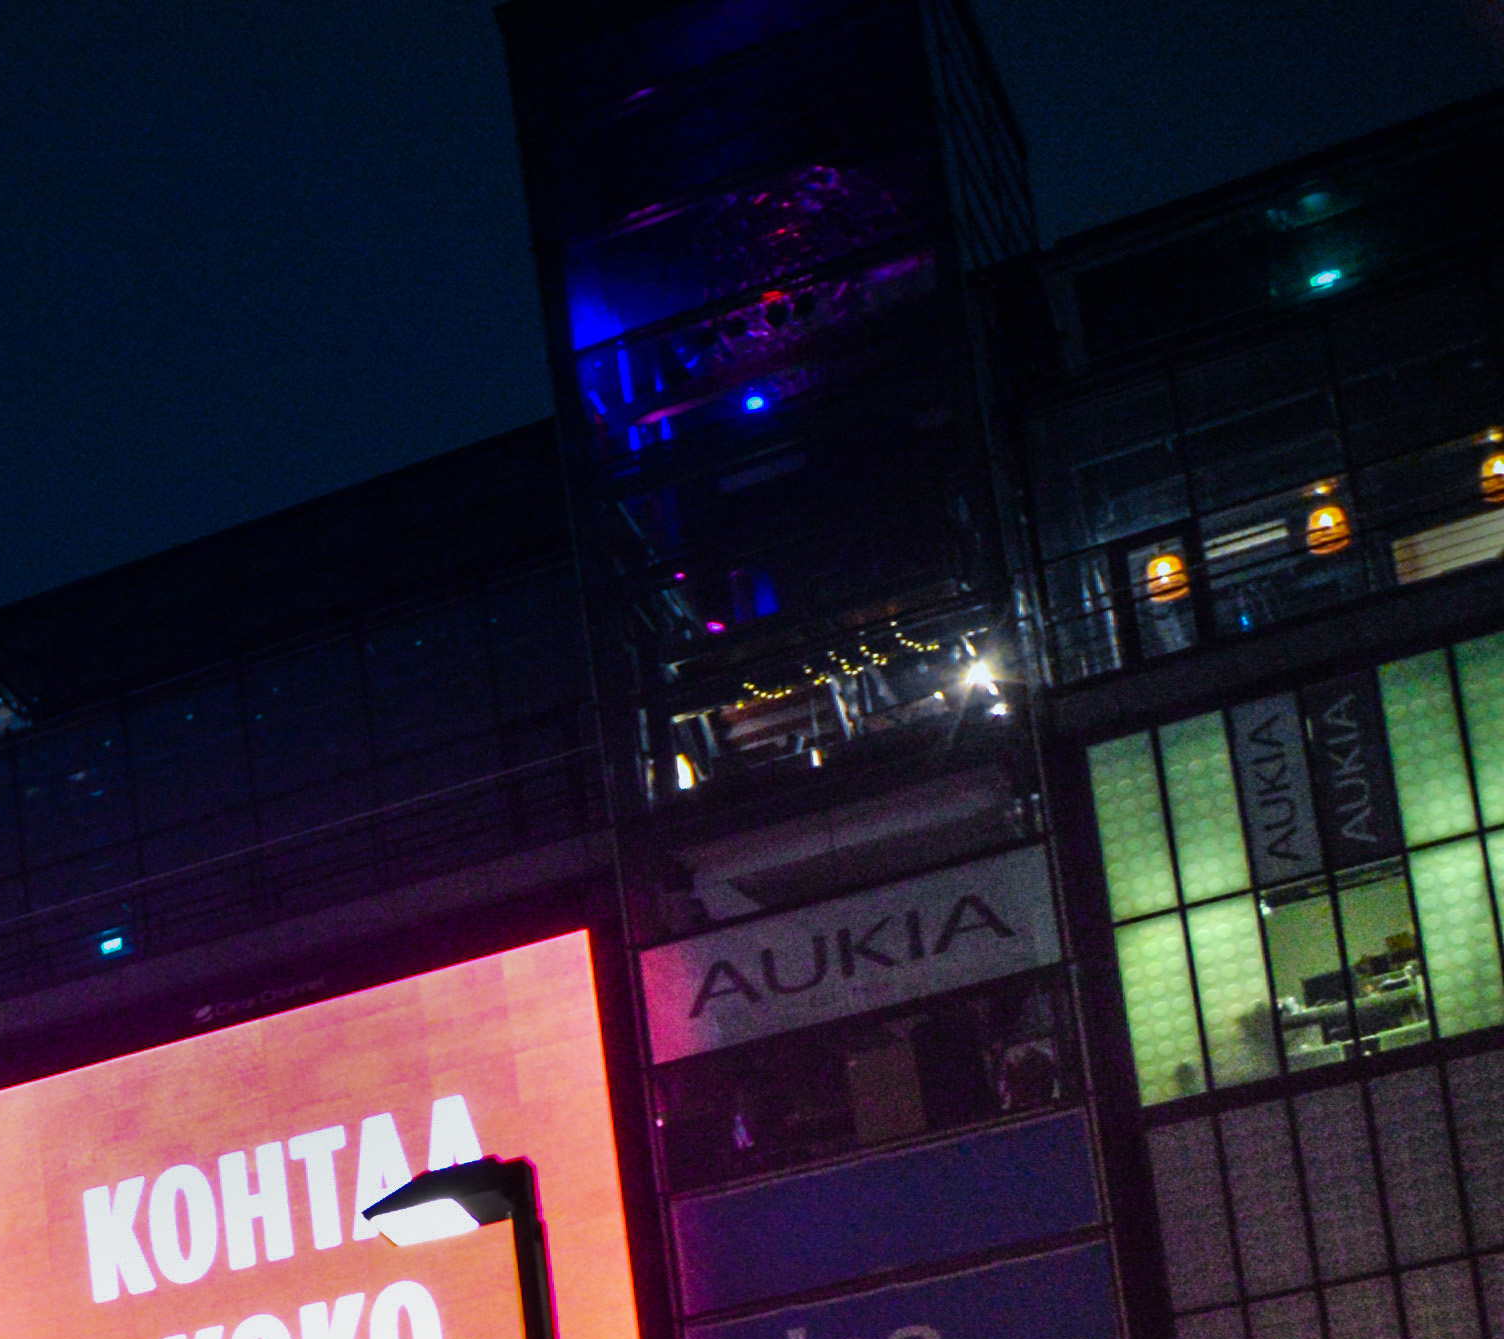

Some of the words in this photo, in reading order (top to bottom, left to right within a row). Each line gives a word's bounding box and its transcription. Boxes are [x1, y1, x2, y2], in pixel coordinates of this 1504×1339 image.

[1252, 708, 1300, 864] AUKIA
[1330, 692, 1376, 844] AUKIA
[689, 892, 1016, 1022] AUKIA
